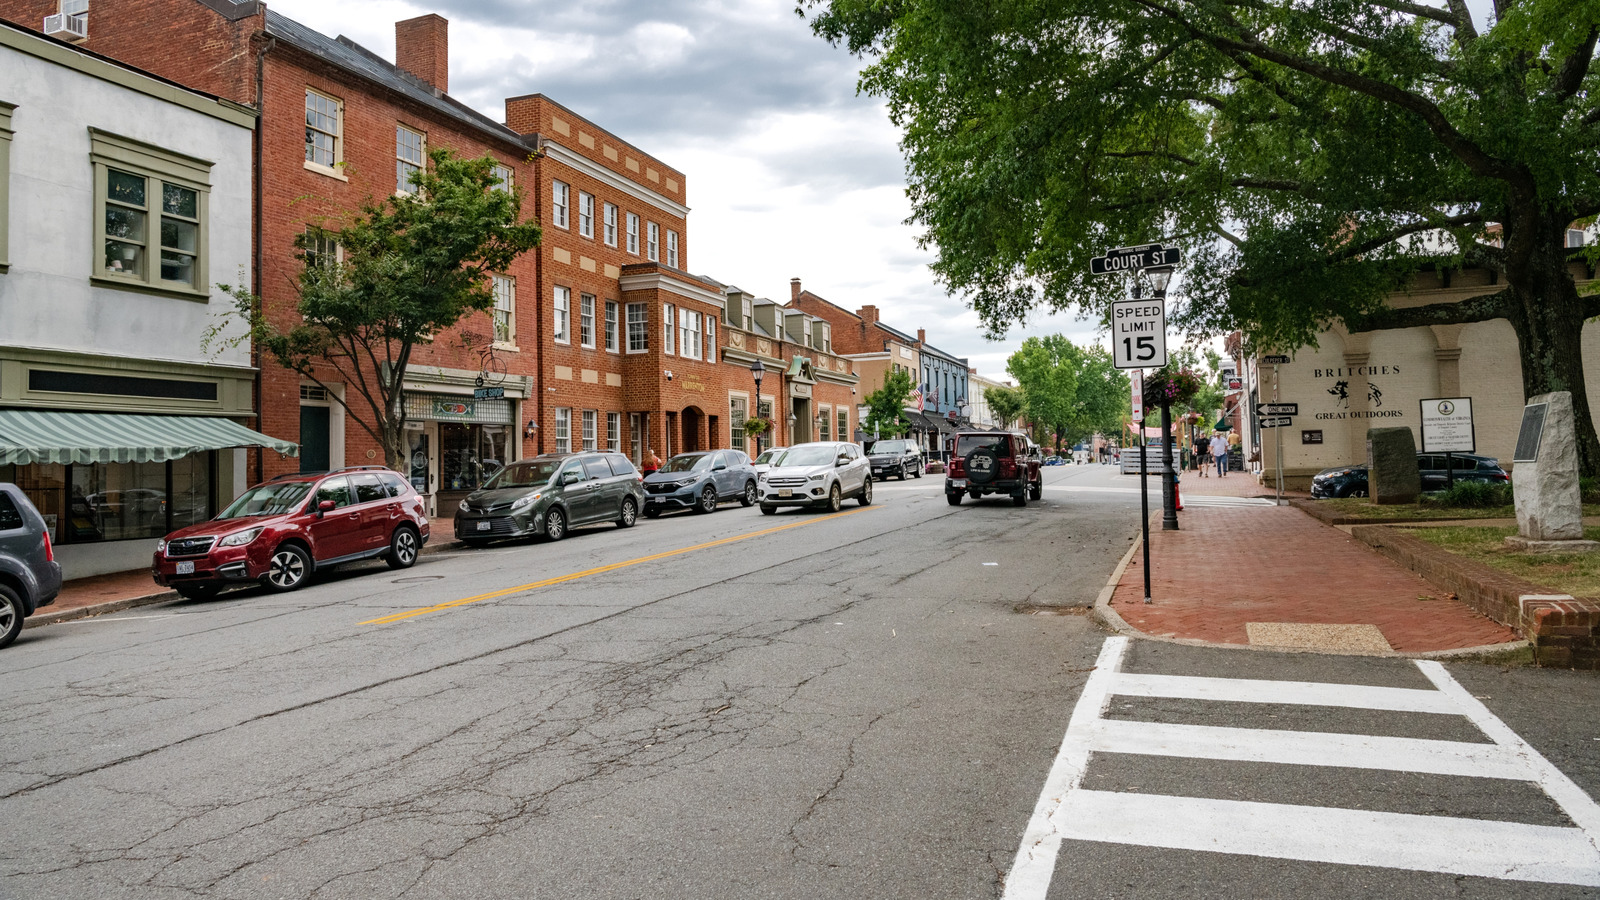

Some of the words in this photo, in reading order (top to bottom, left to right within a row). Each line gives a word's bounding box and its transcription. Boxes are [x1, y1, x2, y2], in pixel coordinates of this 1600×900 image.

[1104, 253, 1145, 271] COURT
[1152, 251, 1167, 264] ST
[1116, 306, 1161, 318] SPEED
[1121, 321, 1156, 333] LIMIT
[1123, 336, 1156, 361] 15
[1314, 365, 1400, 378] BRITCHES
[475, 389, 487, 398] BIKE
[488, 387, 503, 397] SHOP
[1315, 411, 1347, 420] GREAT
[1350, 409, 1403, 419] OUTDOORS
